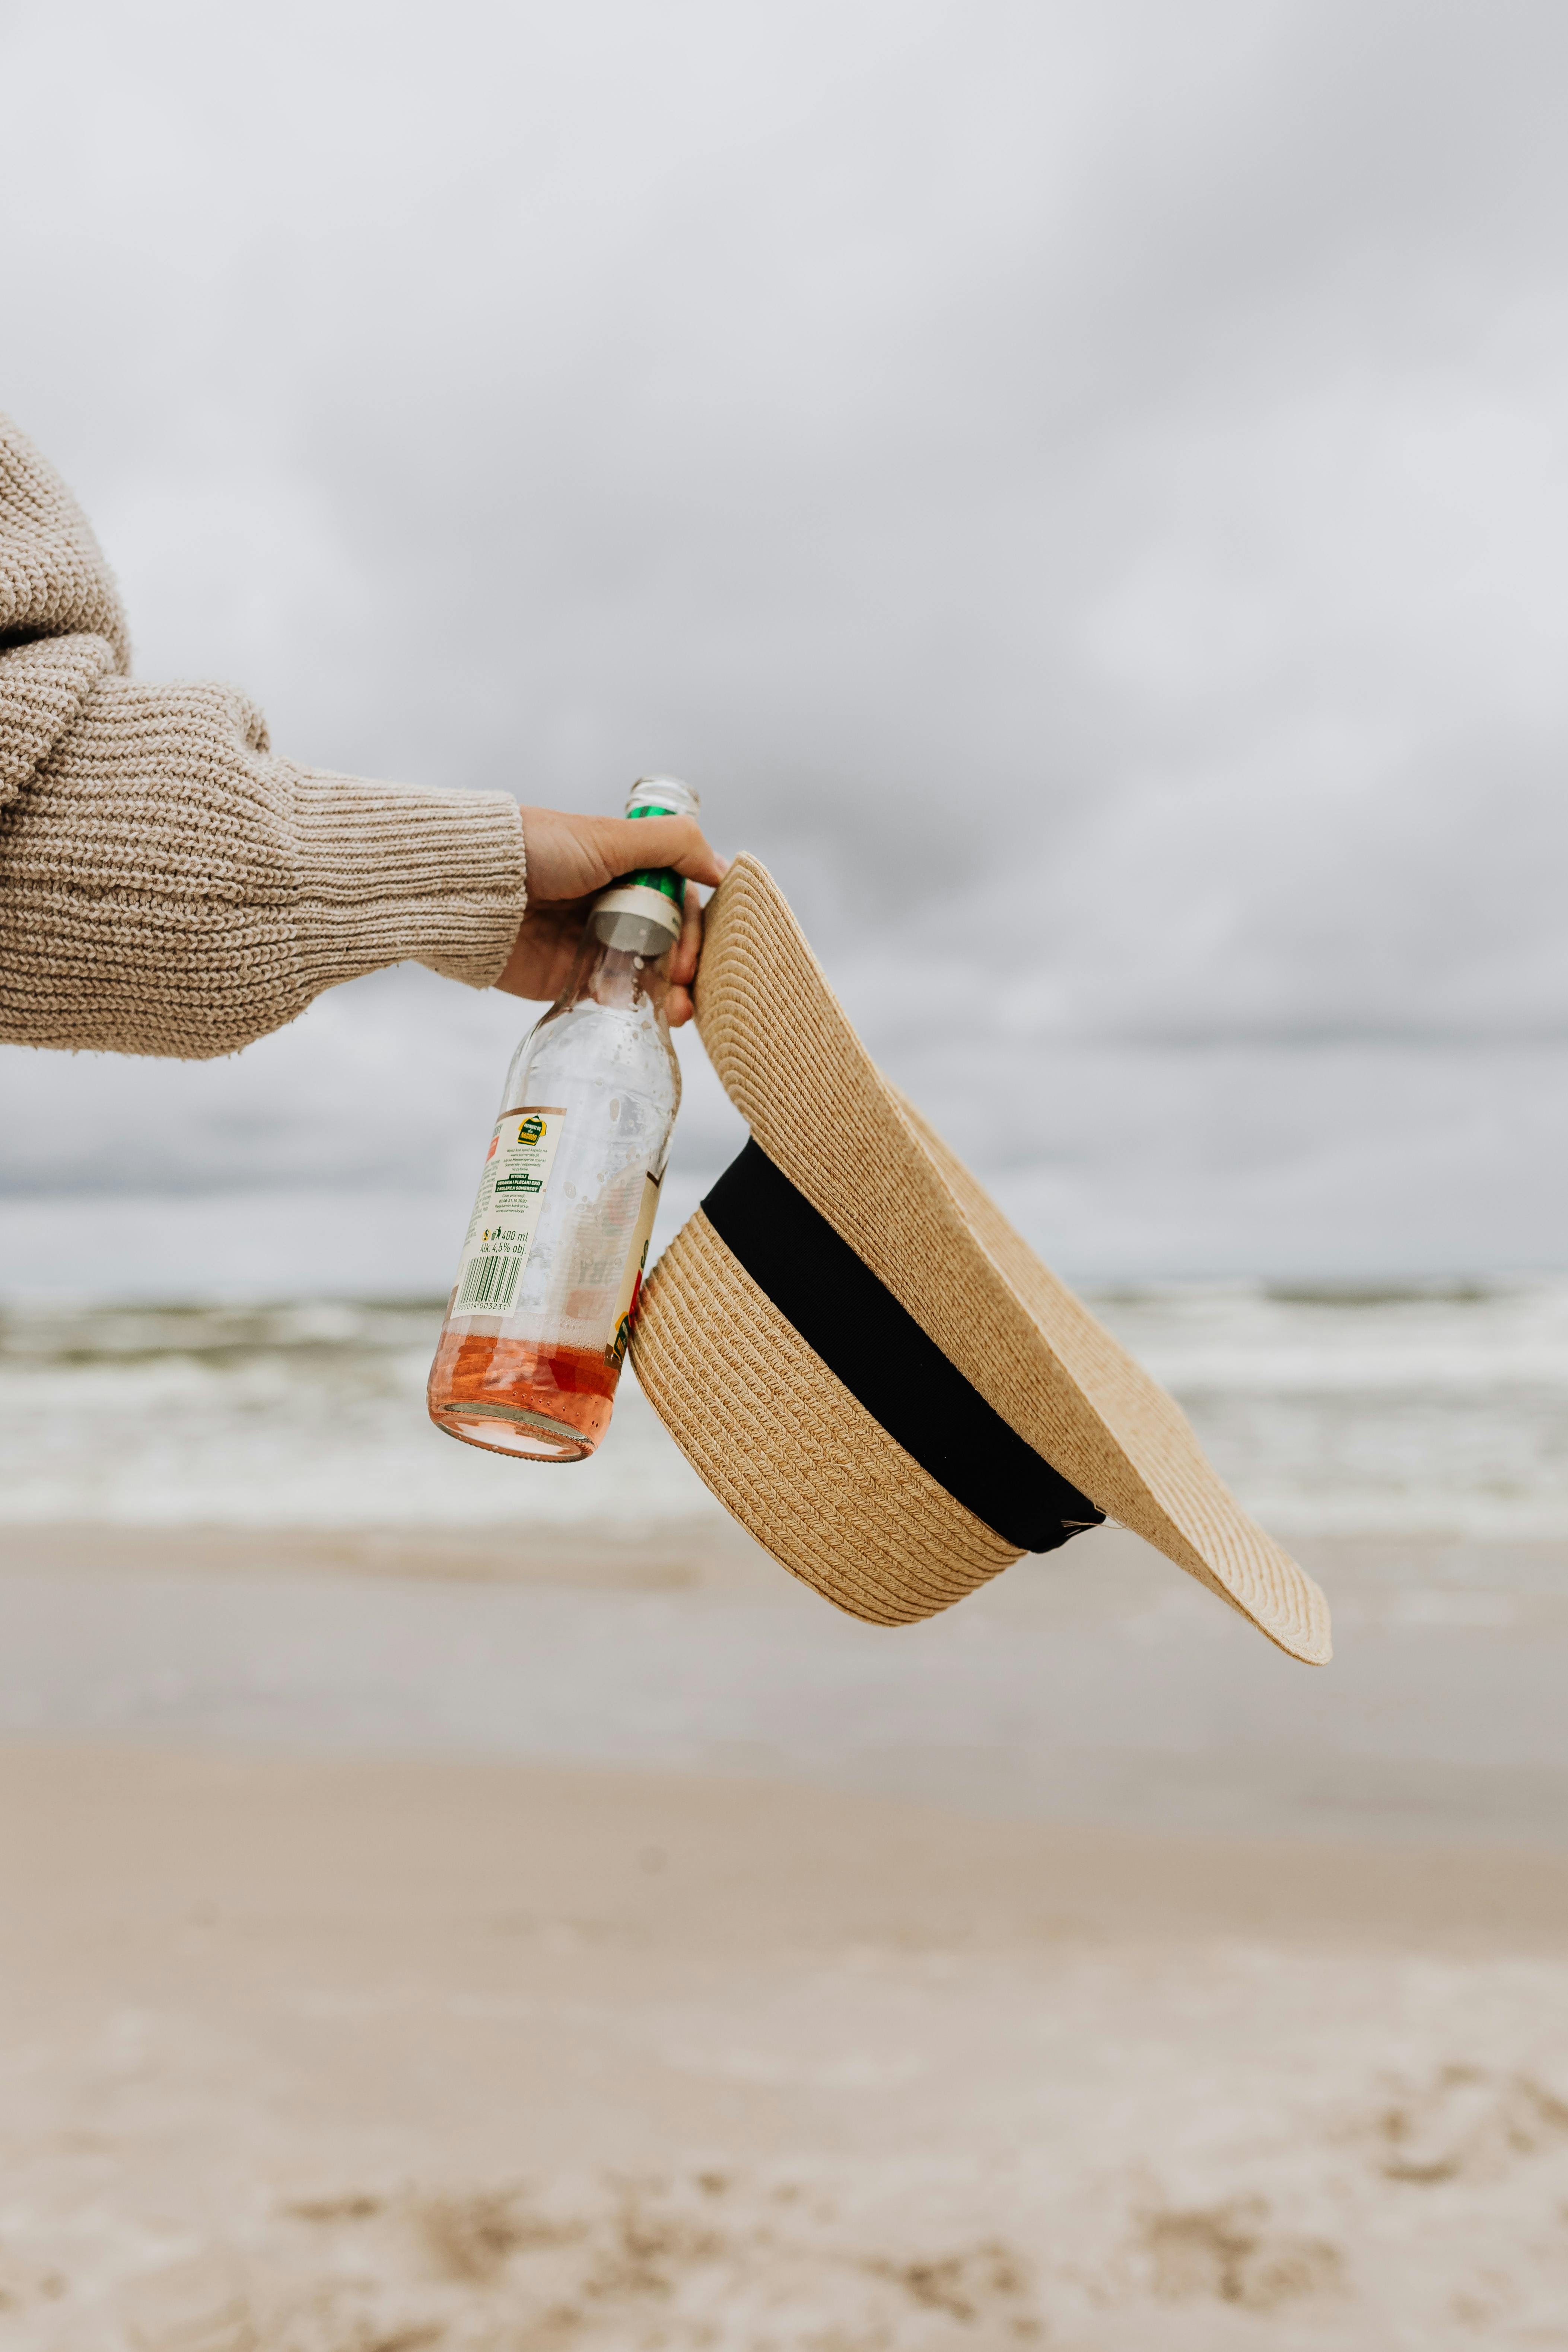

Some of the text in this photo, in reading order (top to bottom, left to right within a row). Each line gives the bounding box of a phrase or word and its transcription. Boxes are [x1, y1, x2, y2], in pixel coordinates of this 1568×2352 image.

[521, 1132, 537, 1141] NAGRÓD
[502, 1230, 528, 1242] 400 ml
[479, 1242, 490, 1253] Alk.
[492, 1242, 510, 1253] 4,5%
[512, 1243, 526, 1256] obj.
[458, 1303, 477, 1311] 900014
